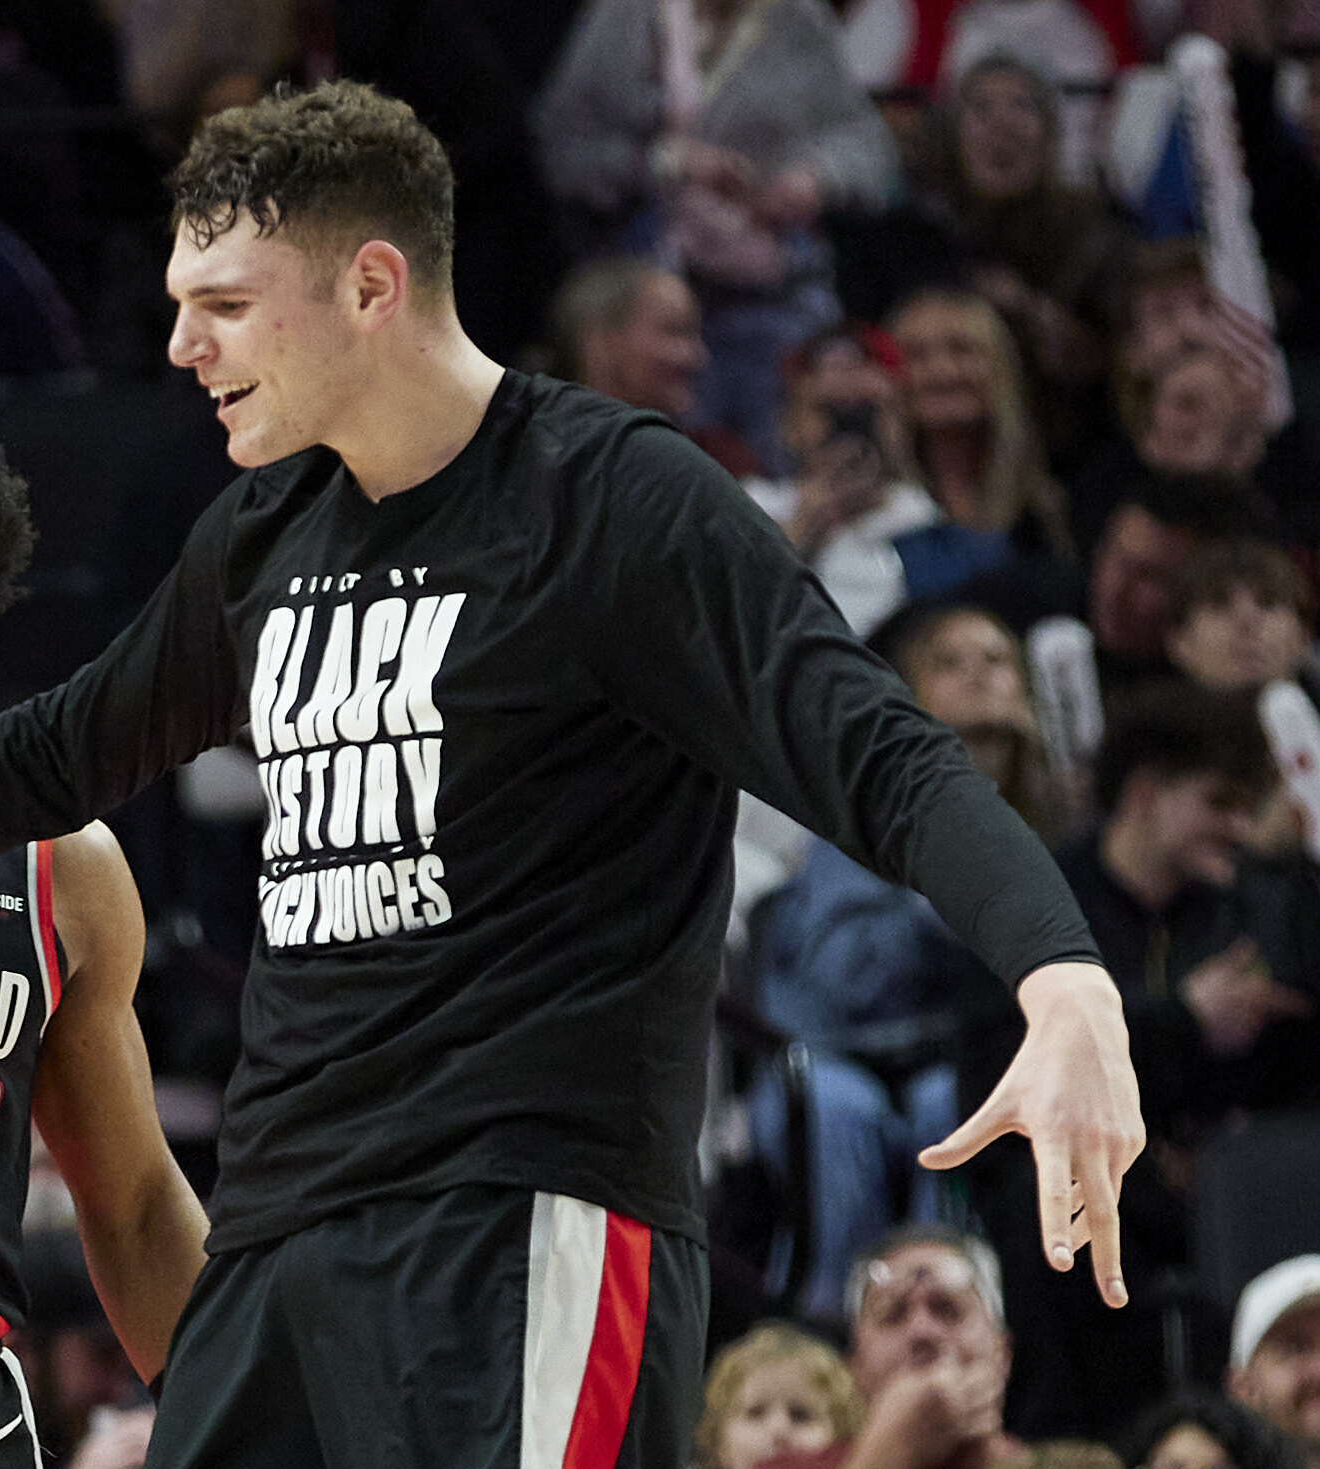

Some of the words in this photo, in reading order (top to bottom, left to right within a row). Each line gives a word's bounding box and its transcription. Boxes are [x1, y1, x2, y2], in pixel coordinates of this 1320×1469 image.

[389, 566, 429, 588] BY
[249, 592, 468, 759] BLACK
[258, 737, 443, 861] ISTORY
[313, 852, 453, 944] VOICES
